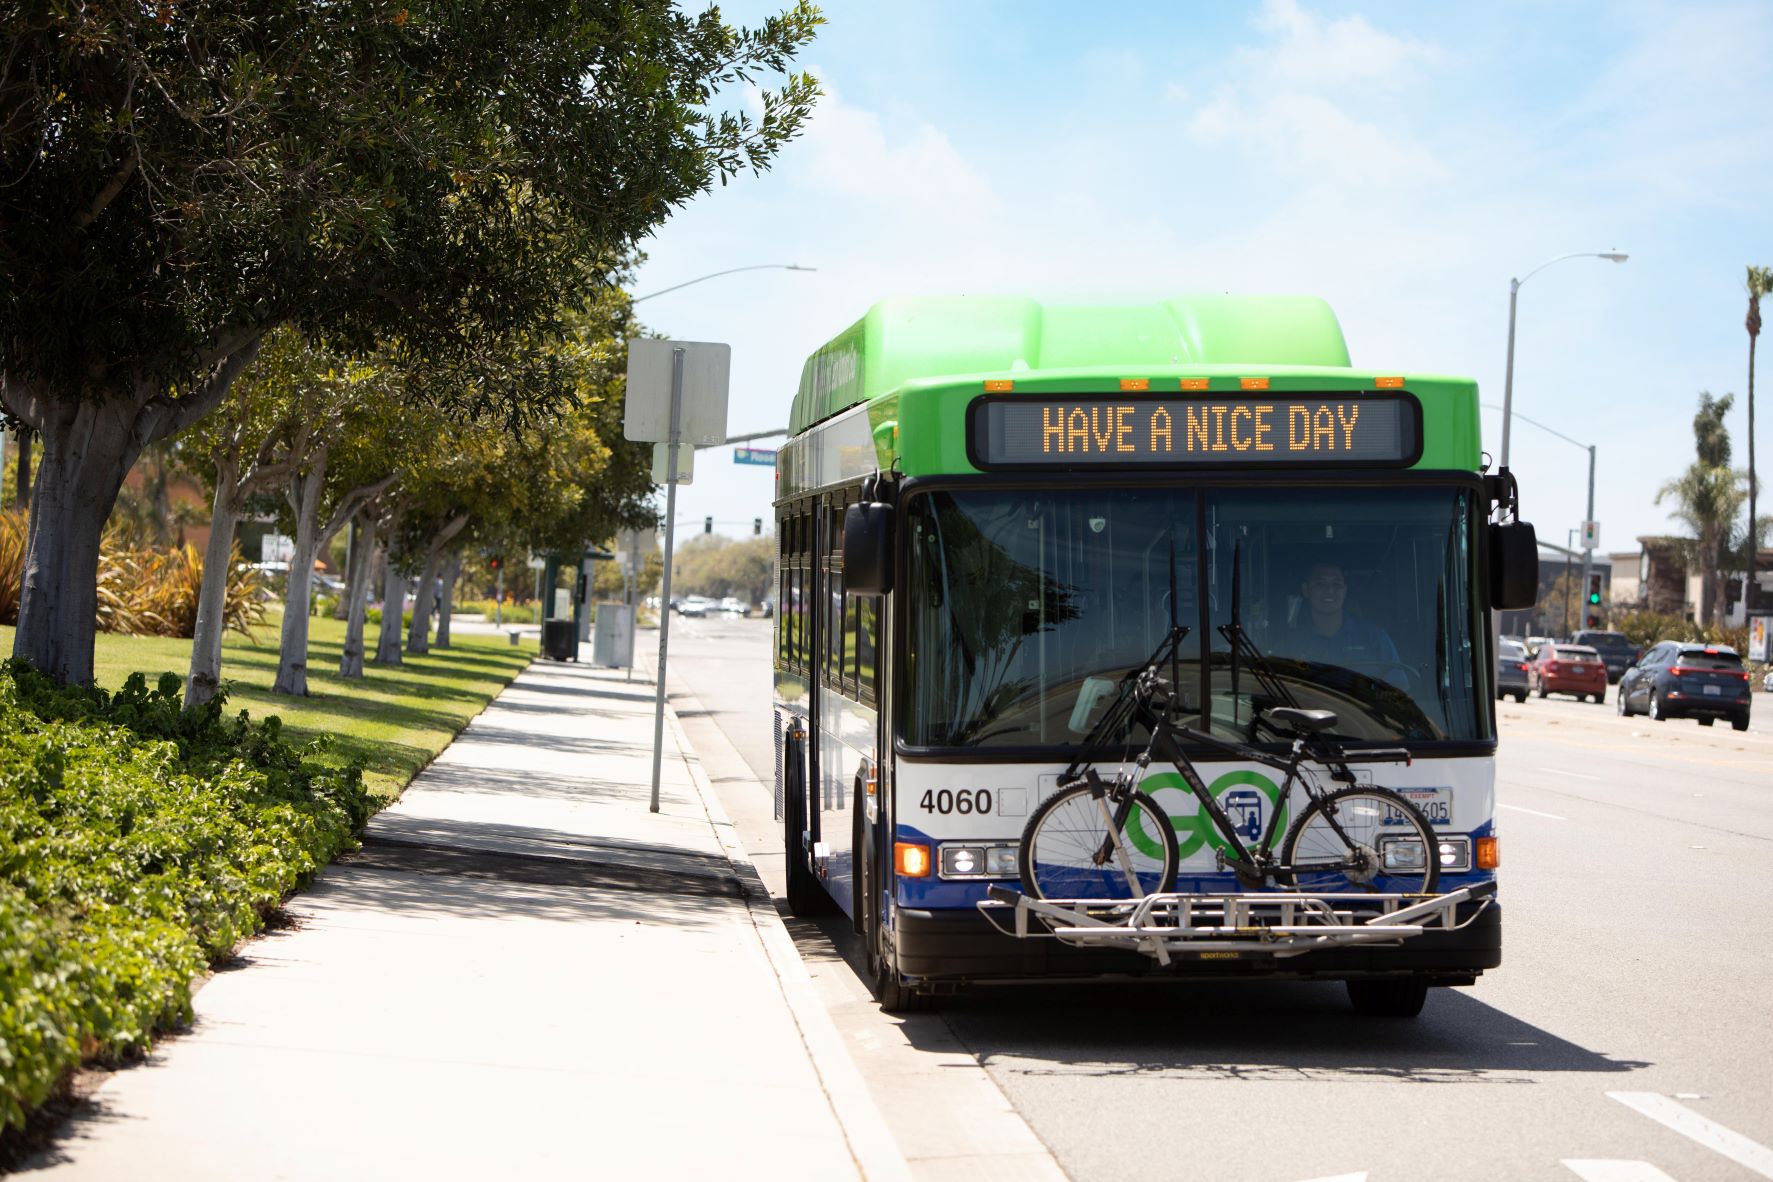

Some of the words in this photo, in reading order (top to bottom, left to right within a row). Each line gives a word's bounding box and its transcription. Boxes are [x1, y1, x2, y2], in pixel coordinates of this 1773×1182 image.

[1043, 406, 1135, 452] HAVE
[1151, 406, 1172, 452] A
[1187, 405, 1274, 451] NICE
[1289, 405, 1359, 451] DAY
[920, 788, 992, 815] 4060
